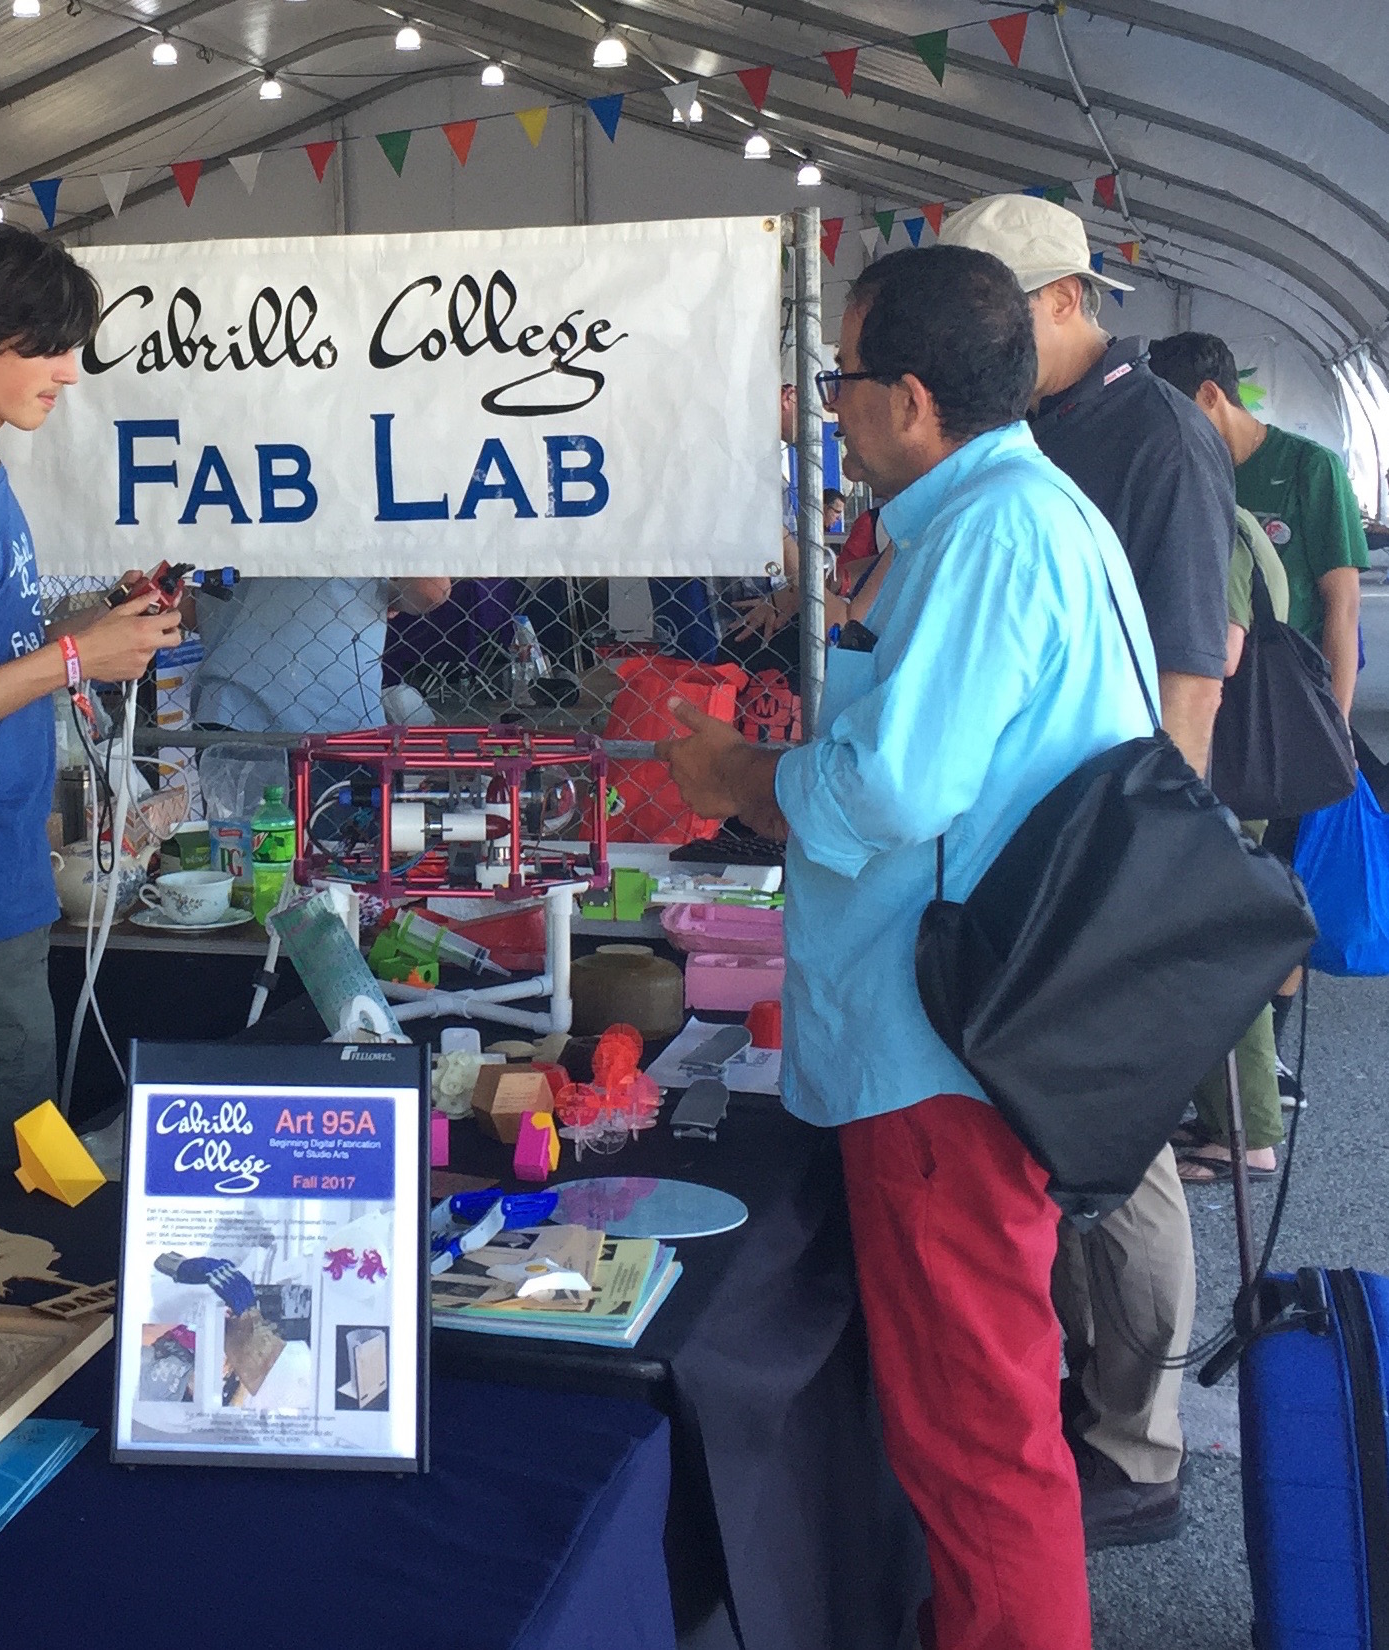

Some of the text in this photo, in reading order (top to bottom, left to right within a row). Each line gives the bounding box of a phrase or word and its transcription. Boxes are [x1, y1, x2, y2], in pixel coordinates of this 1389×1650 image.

[82, 269, 629, 417] Cabrillo College
[156, 1099, 254, 1136] Cabrillo
[275, 1108, 376, 1136] Art 95A
[269, 1138, 381, 1150] Beginning Digital Fabrication
[293, 1150, 349, 1160] for Studio Arts
[174, 1138, 272, 1194] College
[292, 1174, 356, 1190] Fall 2017
